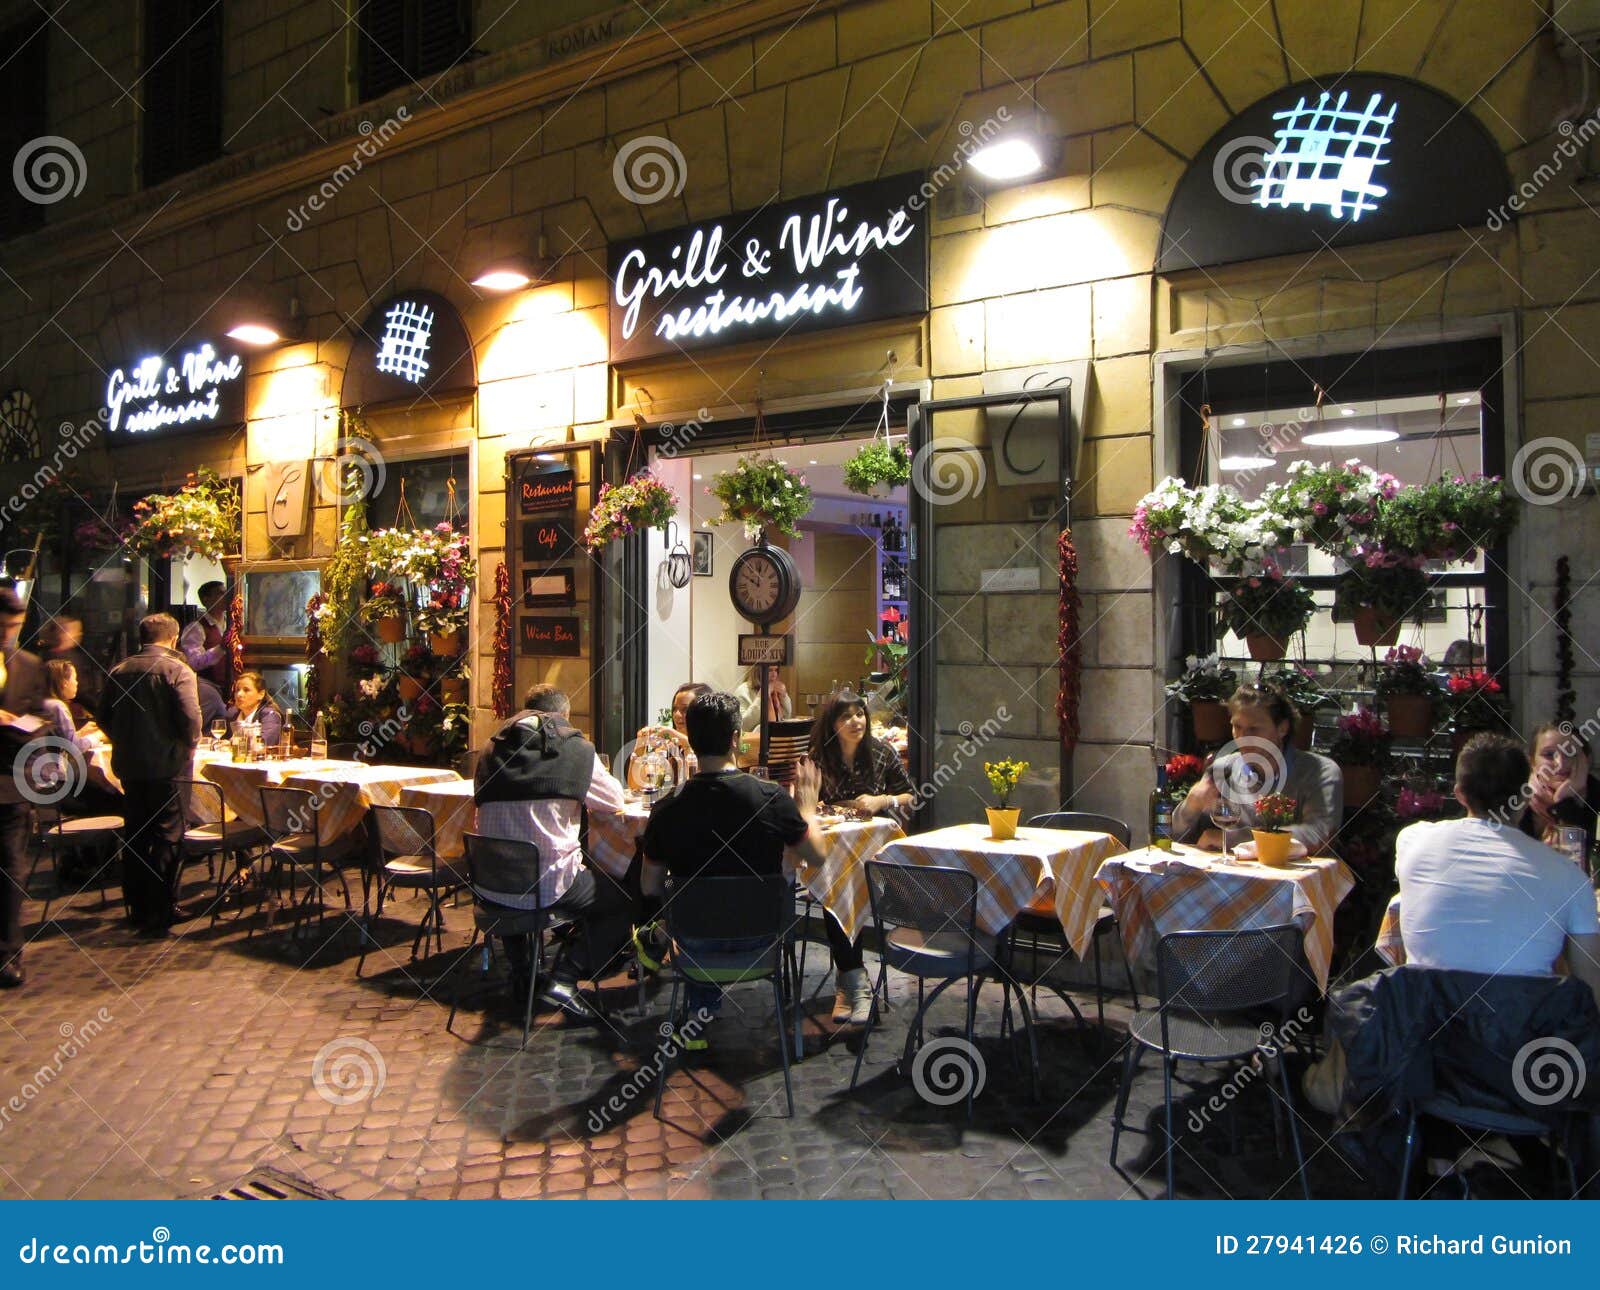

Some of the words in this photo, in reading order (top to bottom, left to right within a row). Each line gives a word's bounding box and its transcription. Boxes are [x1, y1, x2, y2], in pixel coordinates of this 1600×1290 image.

[615, 225, 727, 340] Grill
[742, 238, 771, 277] &
[779, 198, 915, 274] Wine
[655, 262, 864, 340] restaurant
[107, 356, 162, 432] Grill
[165, 367, 180, 394] &
[182, 343, 243, 394] Wine
[522, 479, 573, 499] Restaurant
[525, 623, 551, 640] Wine
[554, 624, 574, 642] Bar
[742, 649, 767, 660] LOUIS
